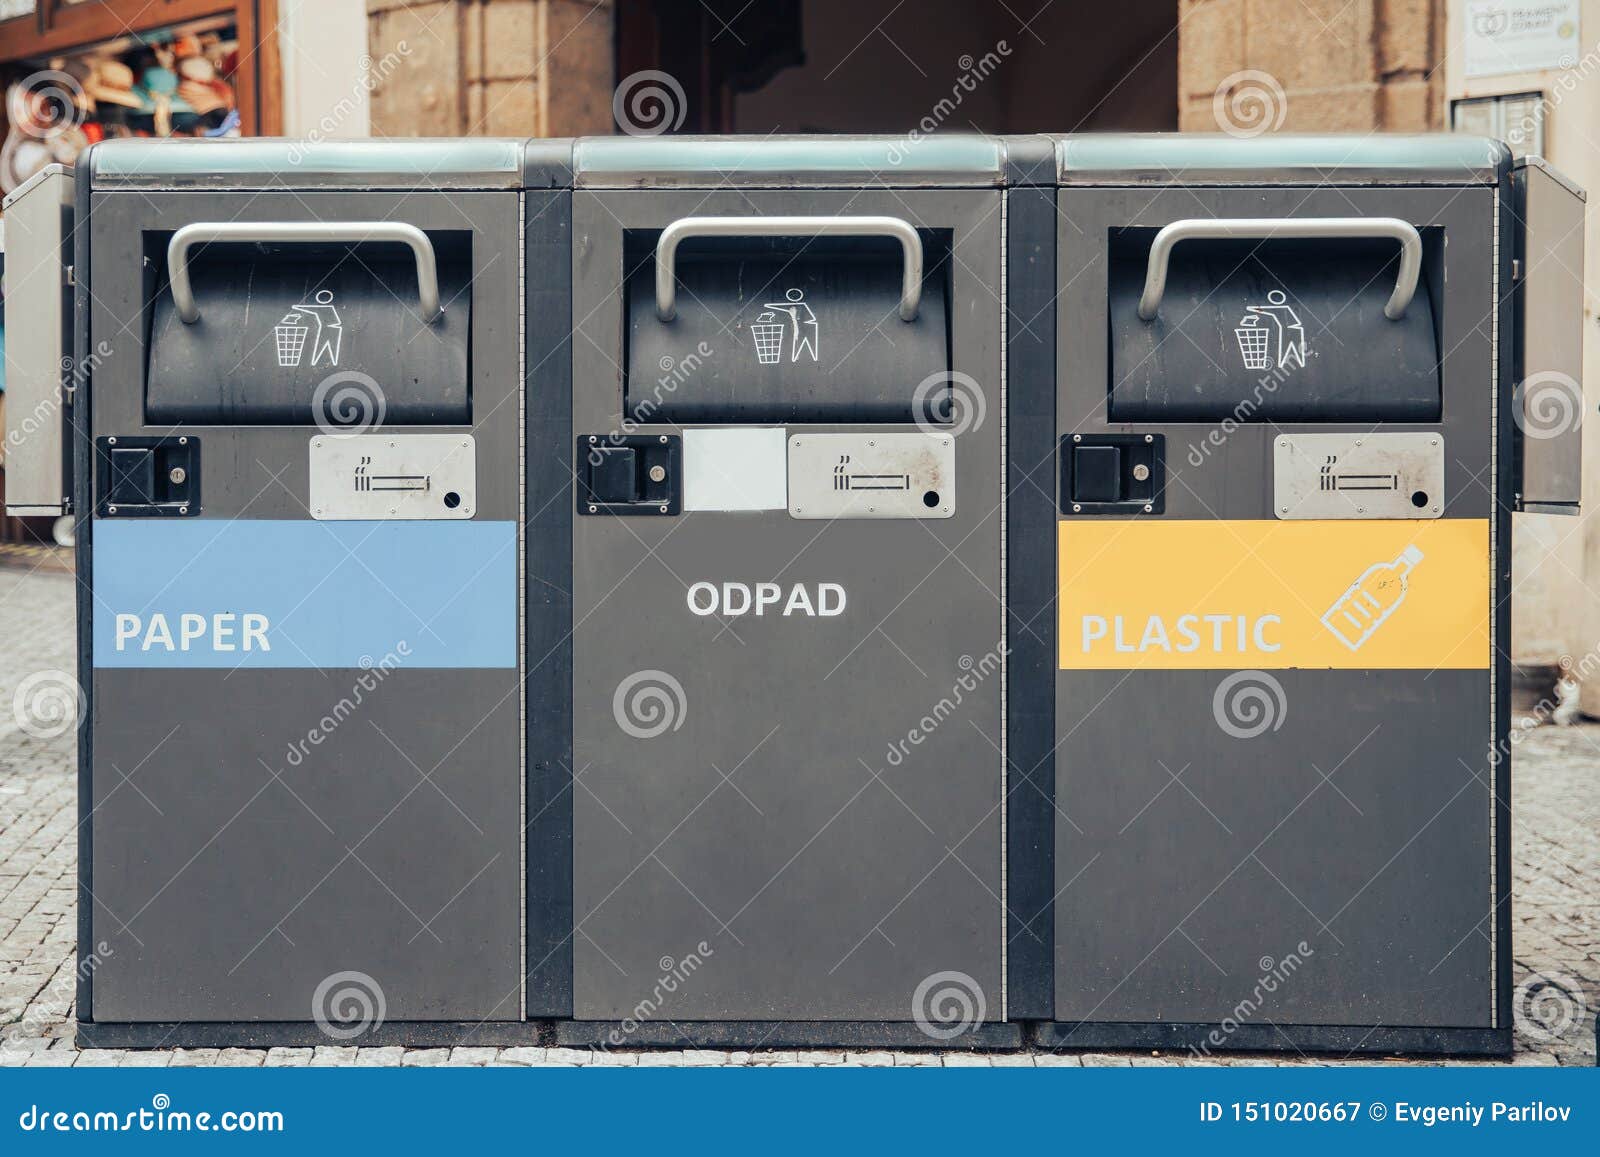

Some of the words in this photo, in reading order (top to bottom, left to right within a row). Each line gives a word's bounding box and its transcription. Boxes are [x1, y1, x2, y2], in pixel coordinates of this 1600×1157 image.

[686, 582, 847, 617] ODPAD
[116, 613, 271, 651] PAPER
[1081, 613, 1282, 653] PLASTIC
